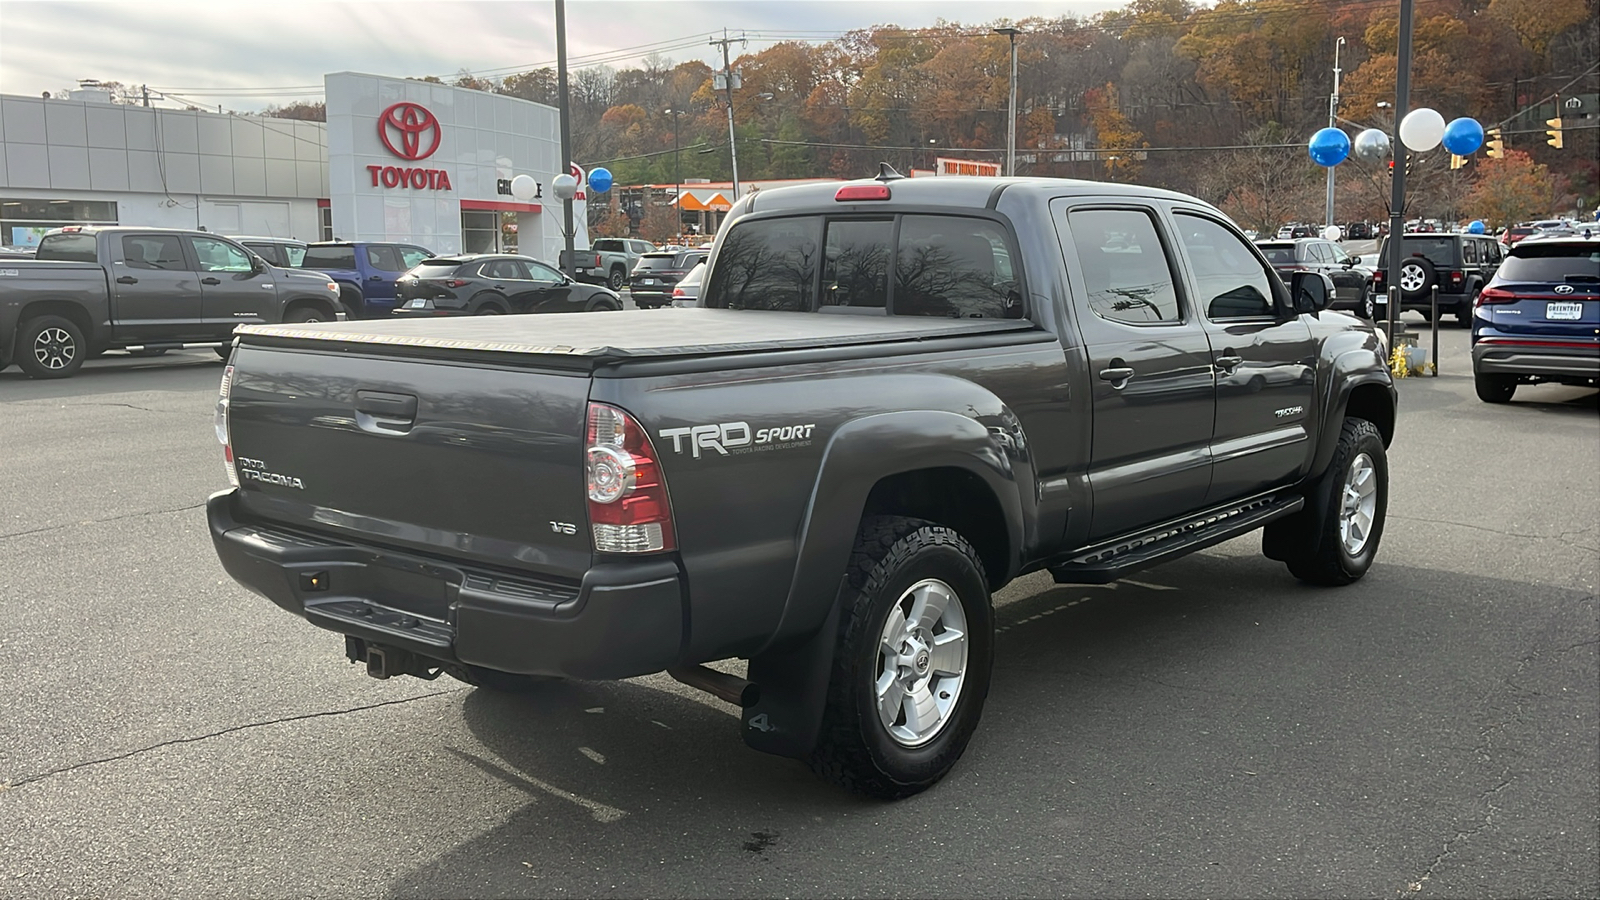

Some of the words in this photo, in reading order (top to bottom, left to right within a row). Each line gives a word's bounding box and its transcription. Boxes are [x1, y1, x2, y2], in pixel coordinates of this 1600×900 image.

[366, 164, 452, 191] TOYOTA
[1548, 304, 1581, 312] GREENTREE
[659, 421, 752, 459] TRD
[755, 424, 816, 444] SPORT
[775, 440, 812, 450] DEVELOPMENT
[238, 457, 268, 469] TOYOTA
[241, 468, 306, 489] TACOMA
[549, 521, 577, 535] V6
